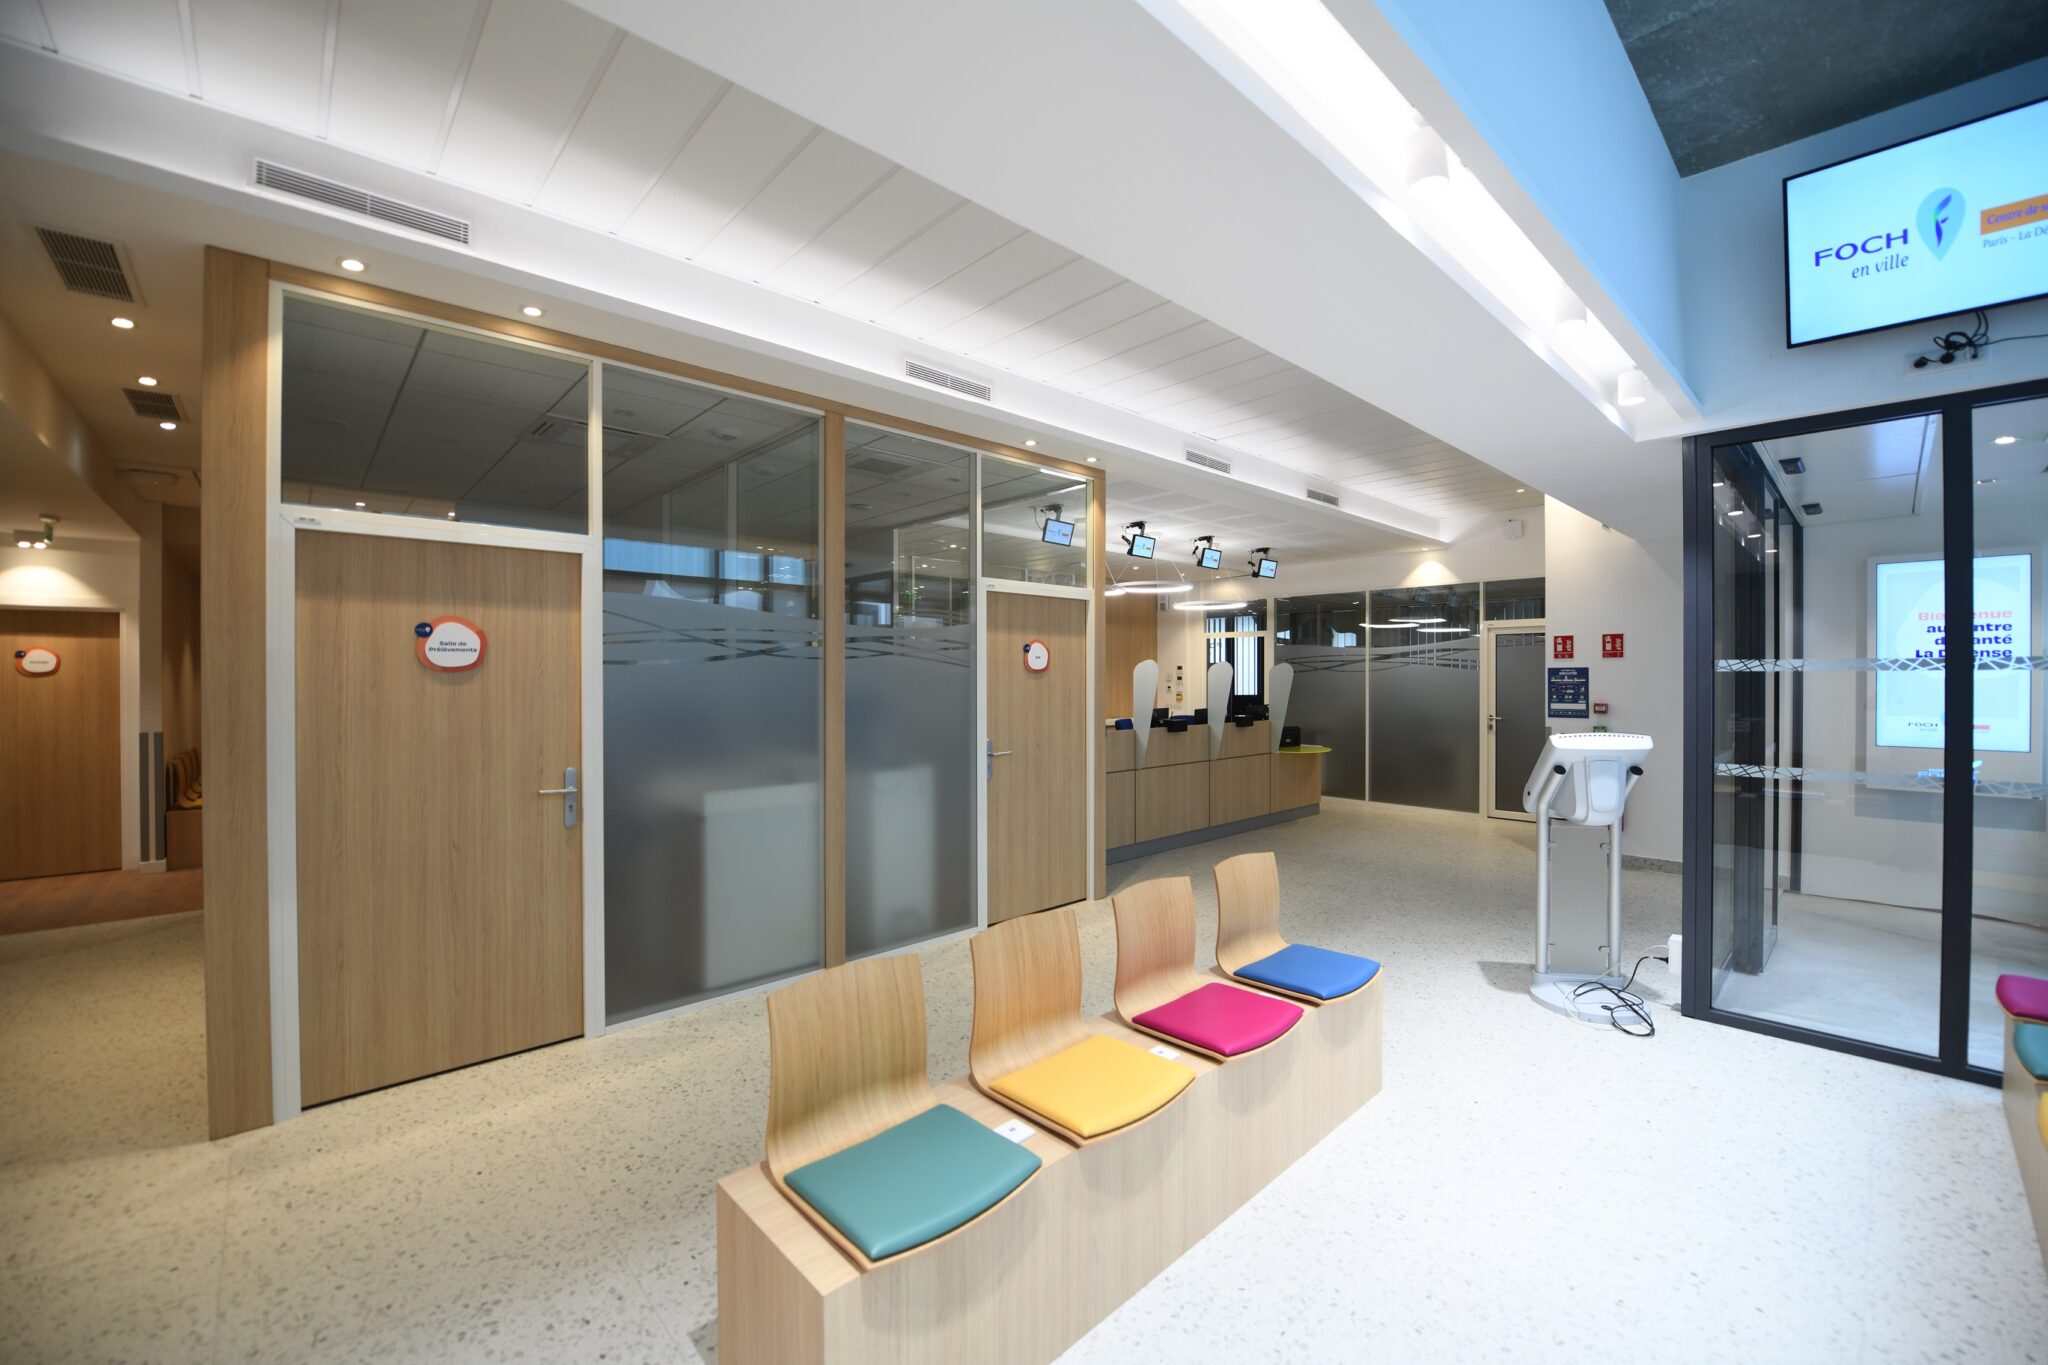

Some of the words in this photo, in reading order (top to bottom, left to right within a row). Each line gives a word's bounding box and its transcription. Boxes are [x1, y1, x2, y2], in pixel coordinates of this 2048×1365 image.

[1986, 208, 2023, 225] Centre
[2025, 204, 2038, 218] de
[1983, 236, 2008, 248] Paris
[2019, 231, 2031, 240] La
[1815, 228, 1908, 267] FOCH
[1852, 265, 1870, 279] en
[1875, 253, 1909, 273] ville
[1918, 610, 2013, 621] Bienue
[1973, 623, 2013, 632] ntre
[1973, 634, 2013, 645] anté
[1915, 649, 1934, 658] La
